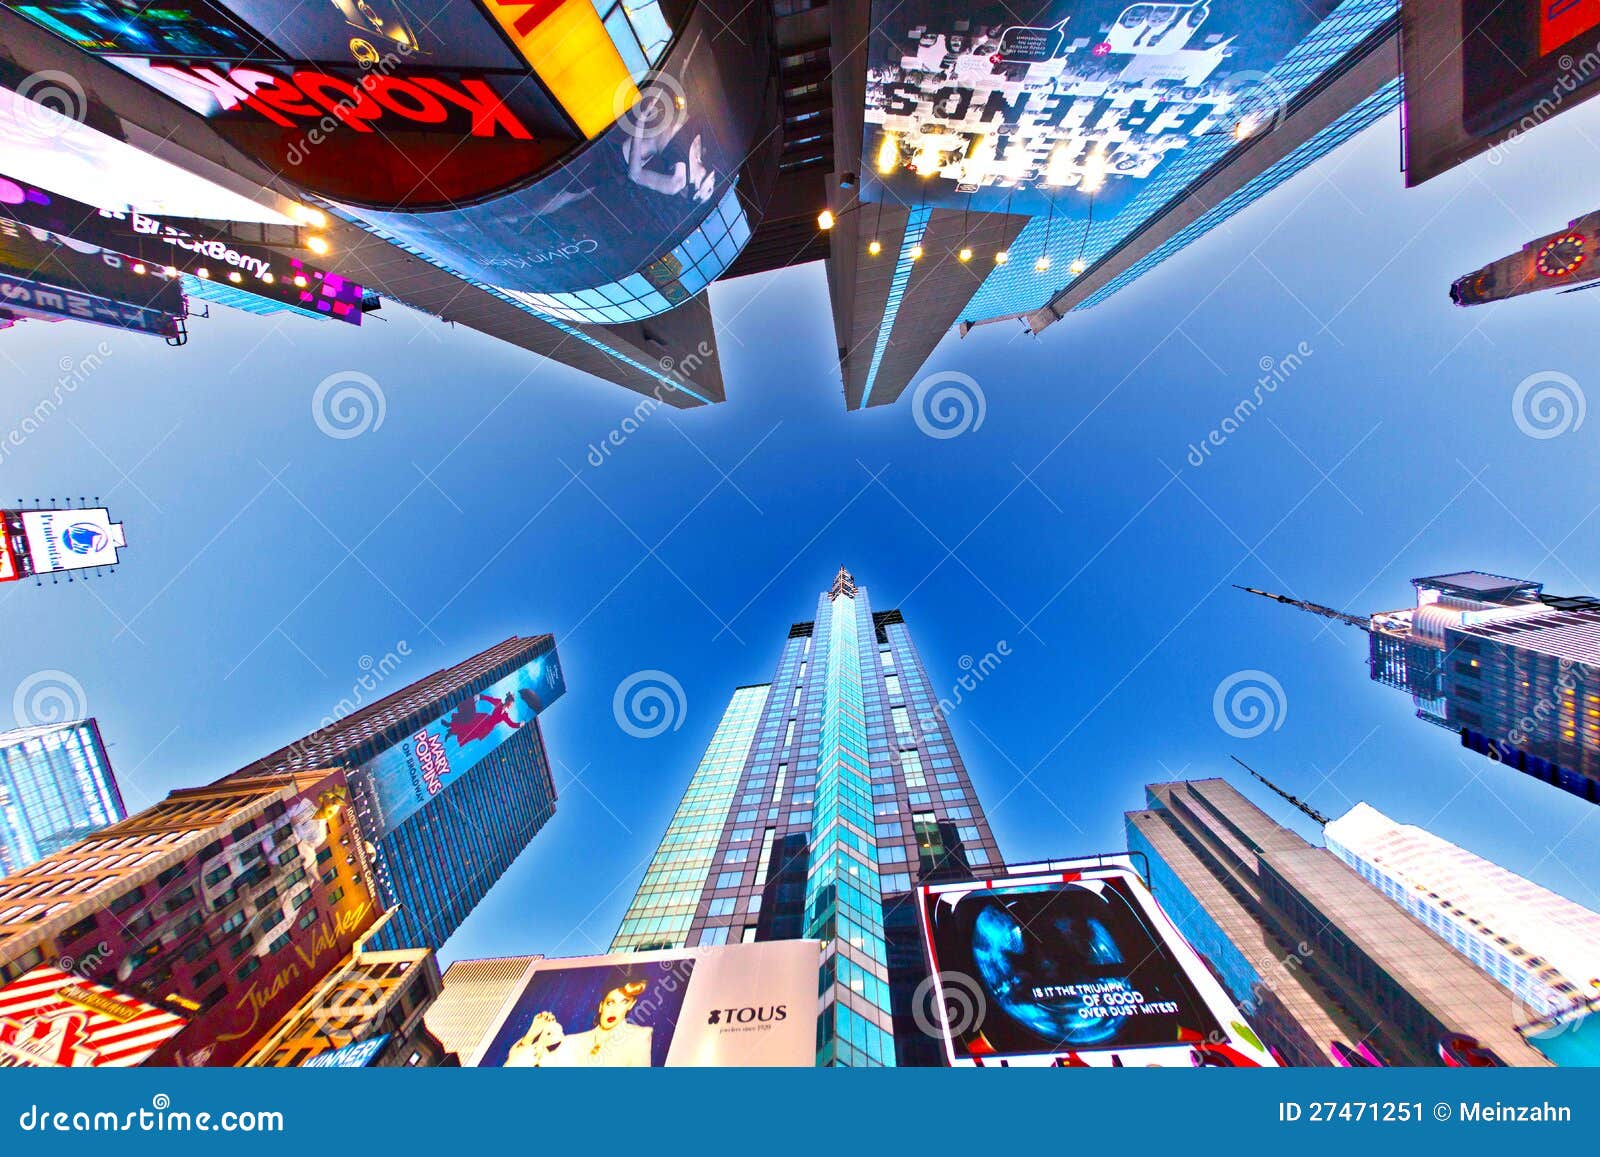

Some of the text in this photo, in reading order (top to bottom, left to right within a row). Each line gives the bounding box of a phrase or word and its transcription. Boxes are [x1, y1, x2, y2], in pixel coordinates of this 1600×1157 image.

[150, 62, 534, 139] Kodak
[882, 82, 1213, 135] FRIENDS
[529, 239, 598, 263] Calvin
[402, 743, 424, 802] ON BROADWAY
[414, 729, 442, 796] POPPINS
[428, 733, 450, 775] MARY
[216, 963, 299, 1042] Juan
[294, 899, 374, 969] Valdez
[1032, 983, 1124, 998] IS IT THE TRIUMPH
[724, 1005, 787, 1023] TOUS
[1078, 1001, 1179, 1019] OVER DUST MITES?
[1083, 991, 1144, 1007] OF GOOD
